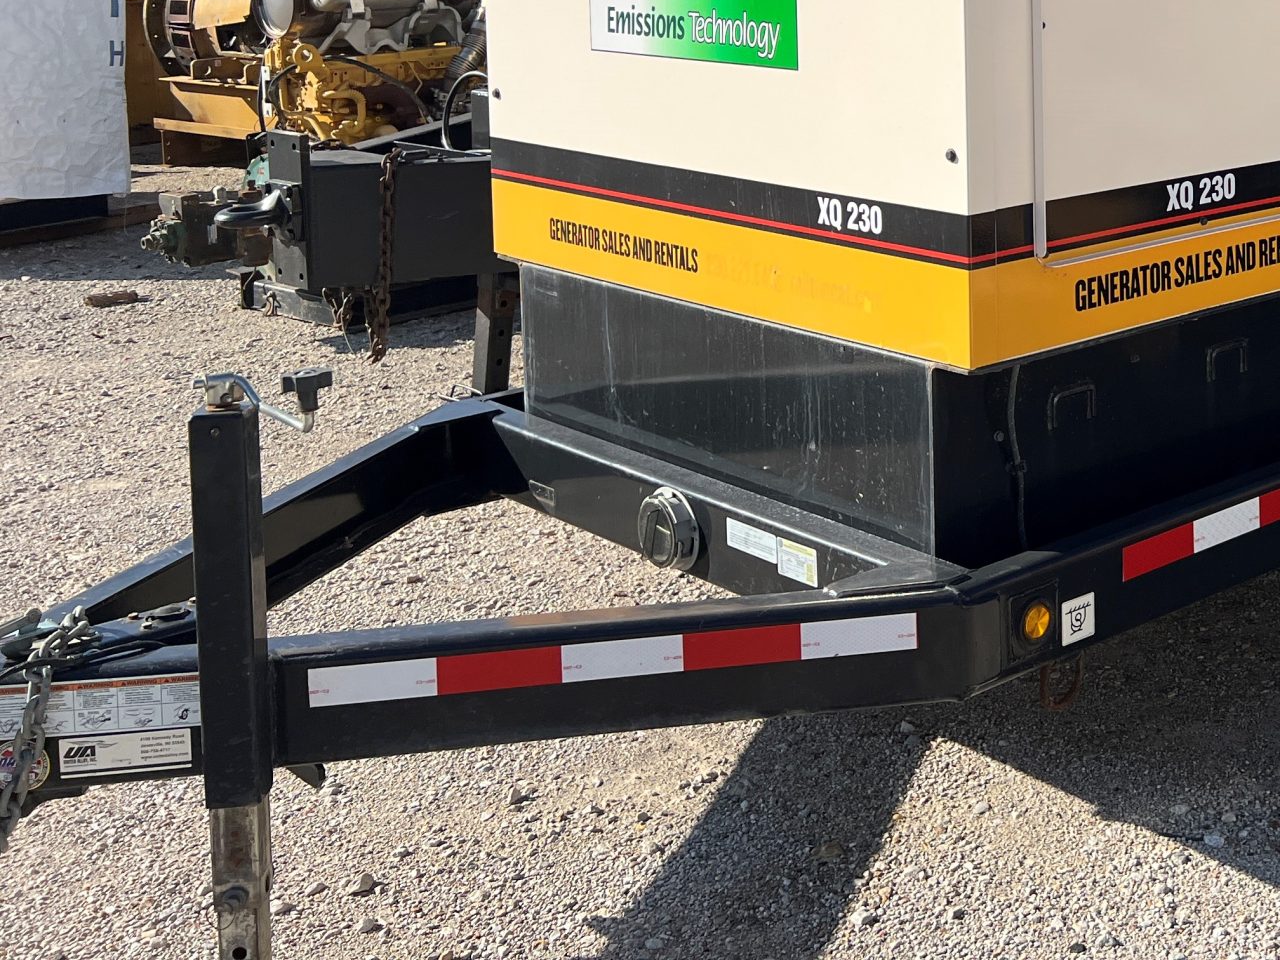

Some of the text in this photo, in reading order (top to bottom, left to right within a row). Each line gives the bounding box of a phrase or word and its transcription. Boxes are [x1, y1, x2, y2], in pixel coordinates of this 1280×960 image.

[607, 5, 780, 59] Emissions Technology
[816, 196, 883, 235] XQ 230
[1166, 173, 1236, 212] XQ 230
[549, 218, 698, 273] GENERATOR SALES AND RENTALS
[1074, 260, 1171, 312] GENERATOR
[1174, 248, 1223, 288] SALES
[1225, 241, 1256, 276] AND
